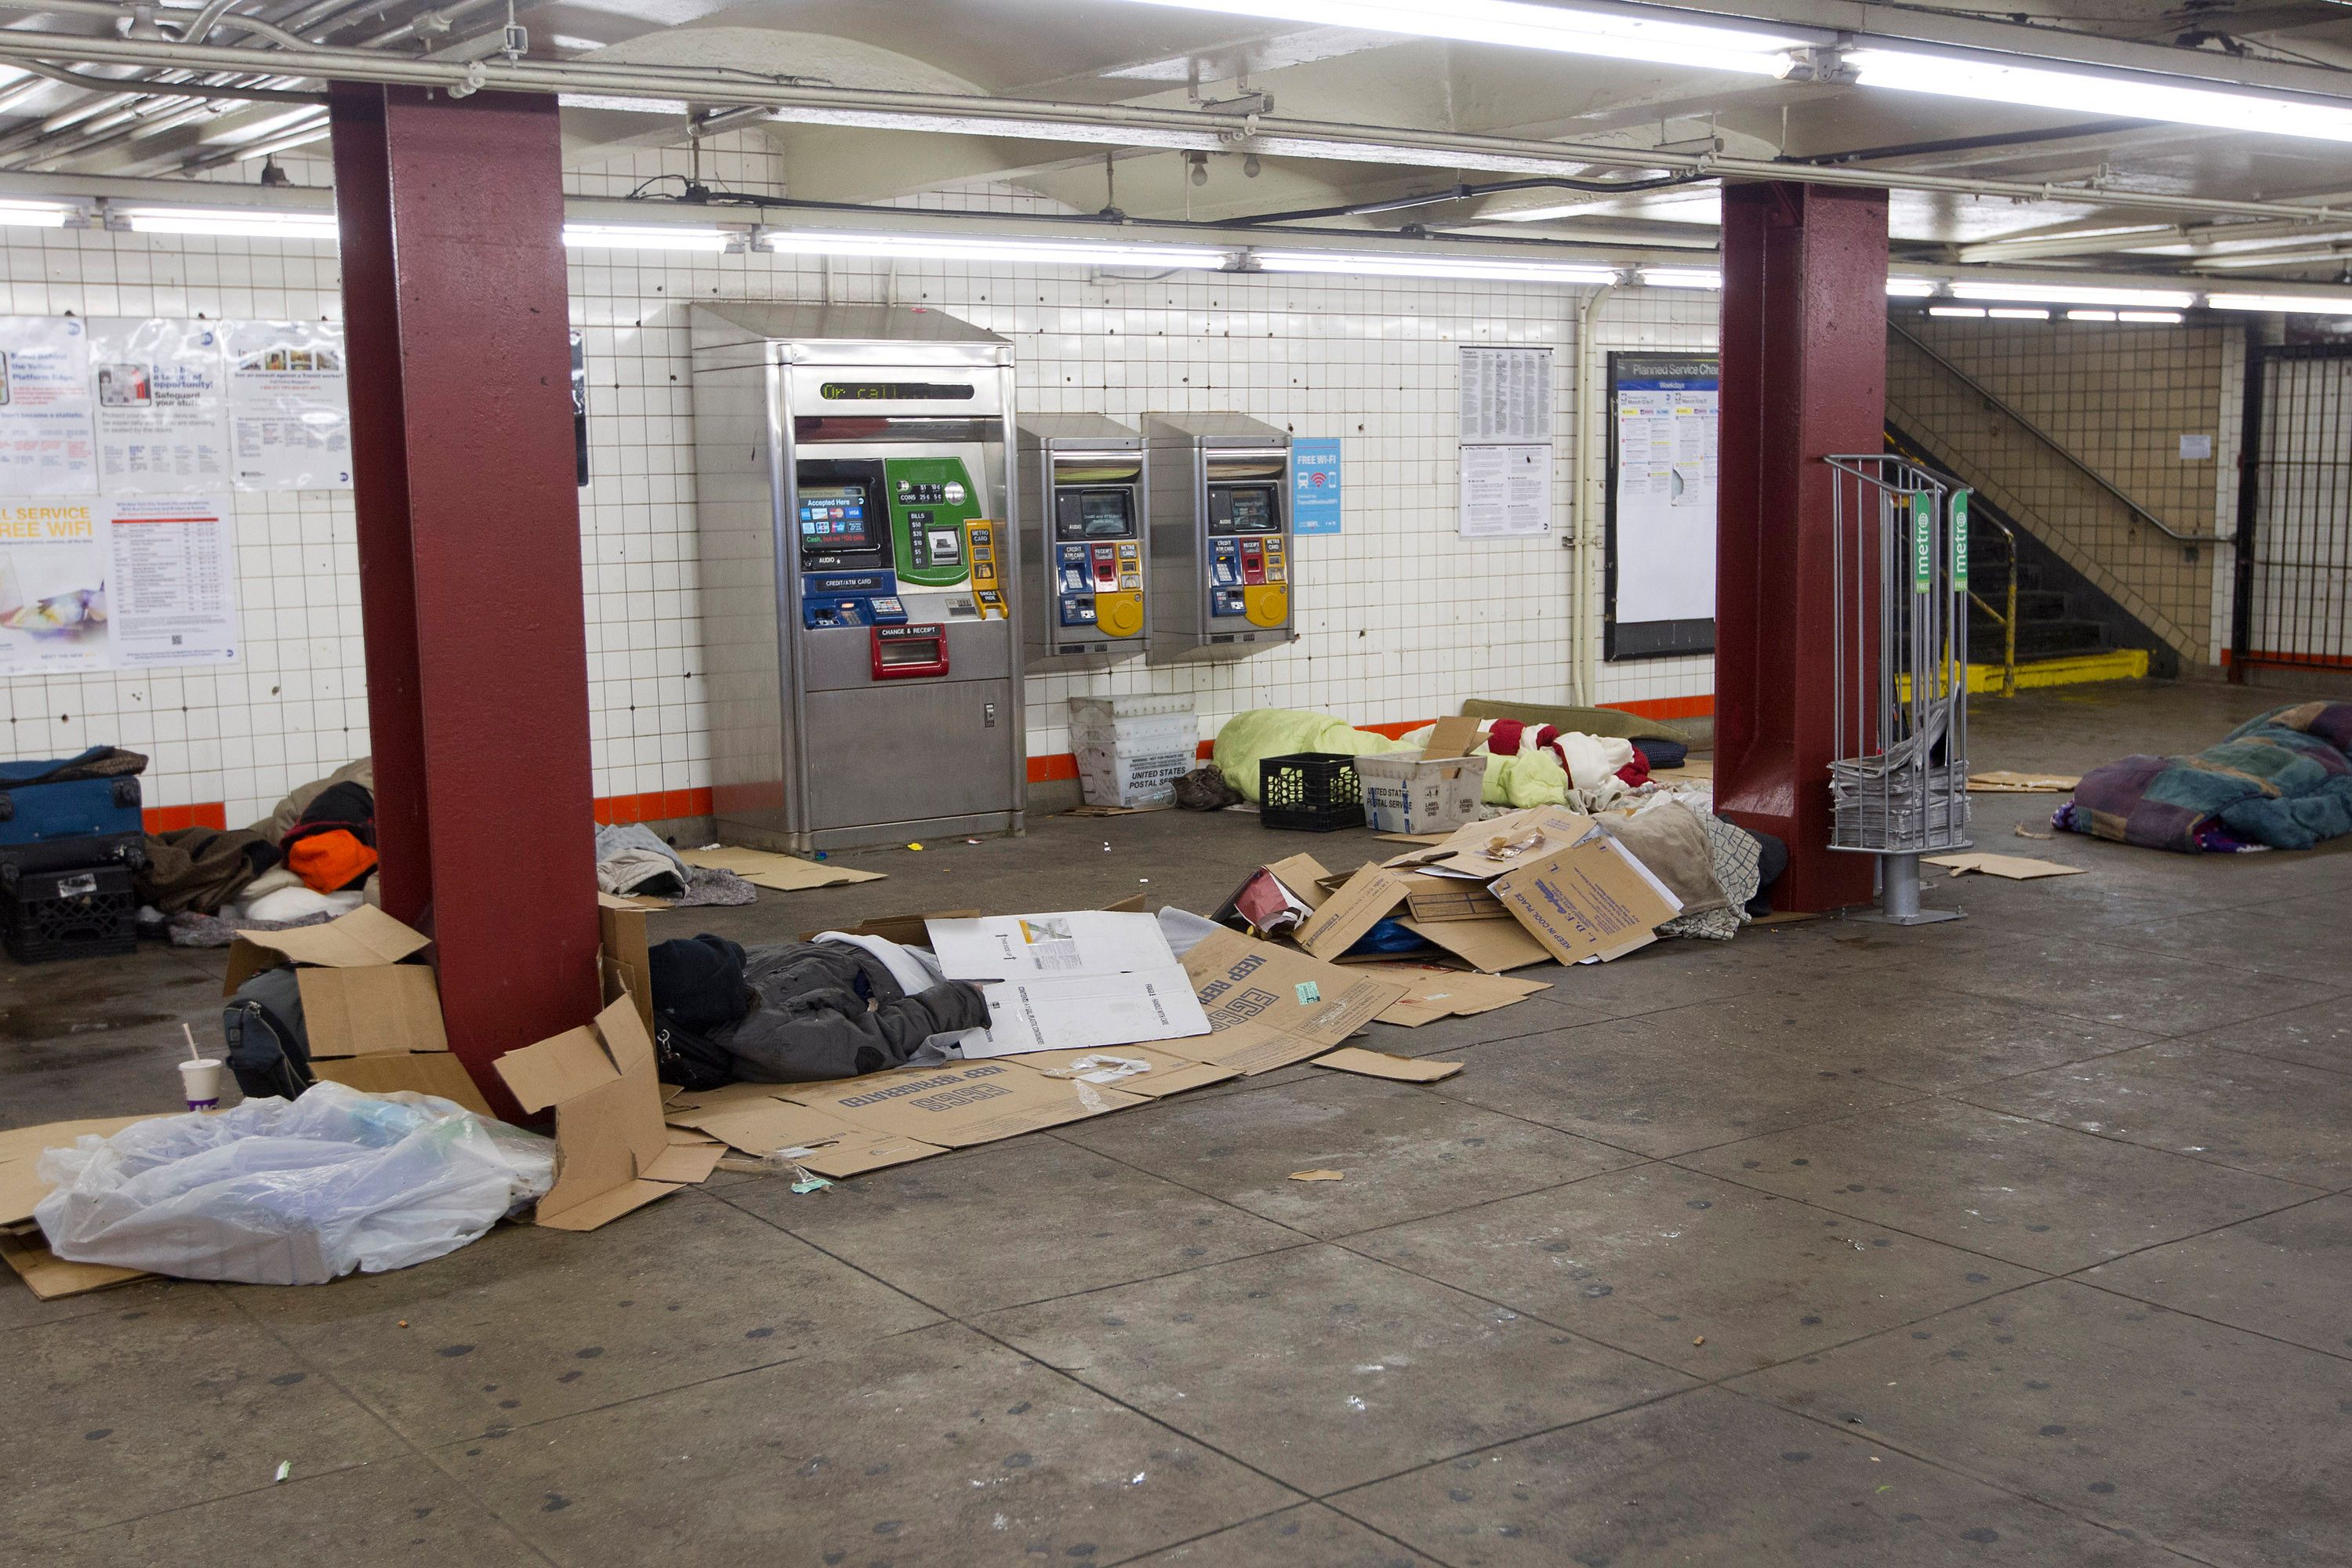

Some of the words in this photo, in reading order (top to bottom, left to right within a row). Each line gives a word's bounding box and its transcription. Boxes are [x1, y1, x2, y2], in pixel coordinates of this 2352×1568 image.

[1633, 364, 1668, 376] Planned
[1669, 363, 1698, 376] Service
[824, 384, 846, 399] Or
[1298, 456, 1316, 465] FREE
[1317, 455, 1336, 464] WI-FI
[17, 506, 90, 521] SERVICE
[48, 521, 93, 537] WIFI
[1916, 513, 1929, 575] metro
[1955, 512, 1967, 573] metro
[1132, 771, 1158, 780] UNITED
[1160, 767, 1186, 777] STATES
[1129, 779, 1157, 789] POSTAL
[1514, 892, 1535, 913] PLACE
[1533, 911, 1551, 928] COOL
[1554, 932, 1571, 950] KEEP
[1227, 954, 1268, 982] KEEP
[1145, 983, 1157, 997] FRAGILE
[1152, 998, 1163, 1011] HANDLE
[1029, 1014, 1039, 1027] PLASTIC
[963, 1065, 1009, 1080] KEEP
[837, 1075, 966, 1109] REFRIGERATED
[909, 1083, 1013, 1112] EGGS
